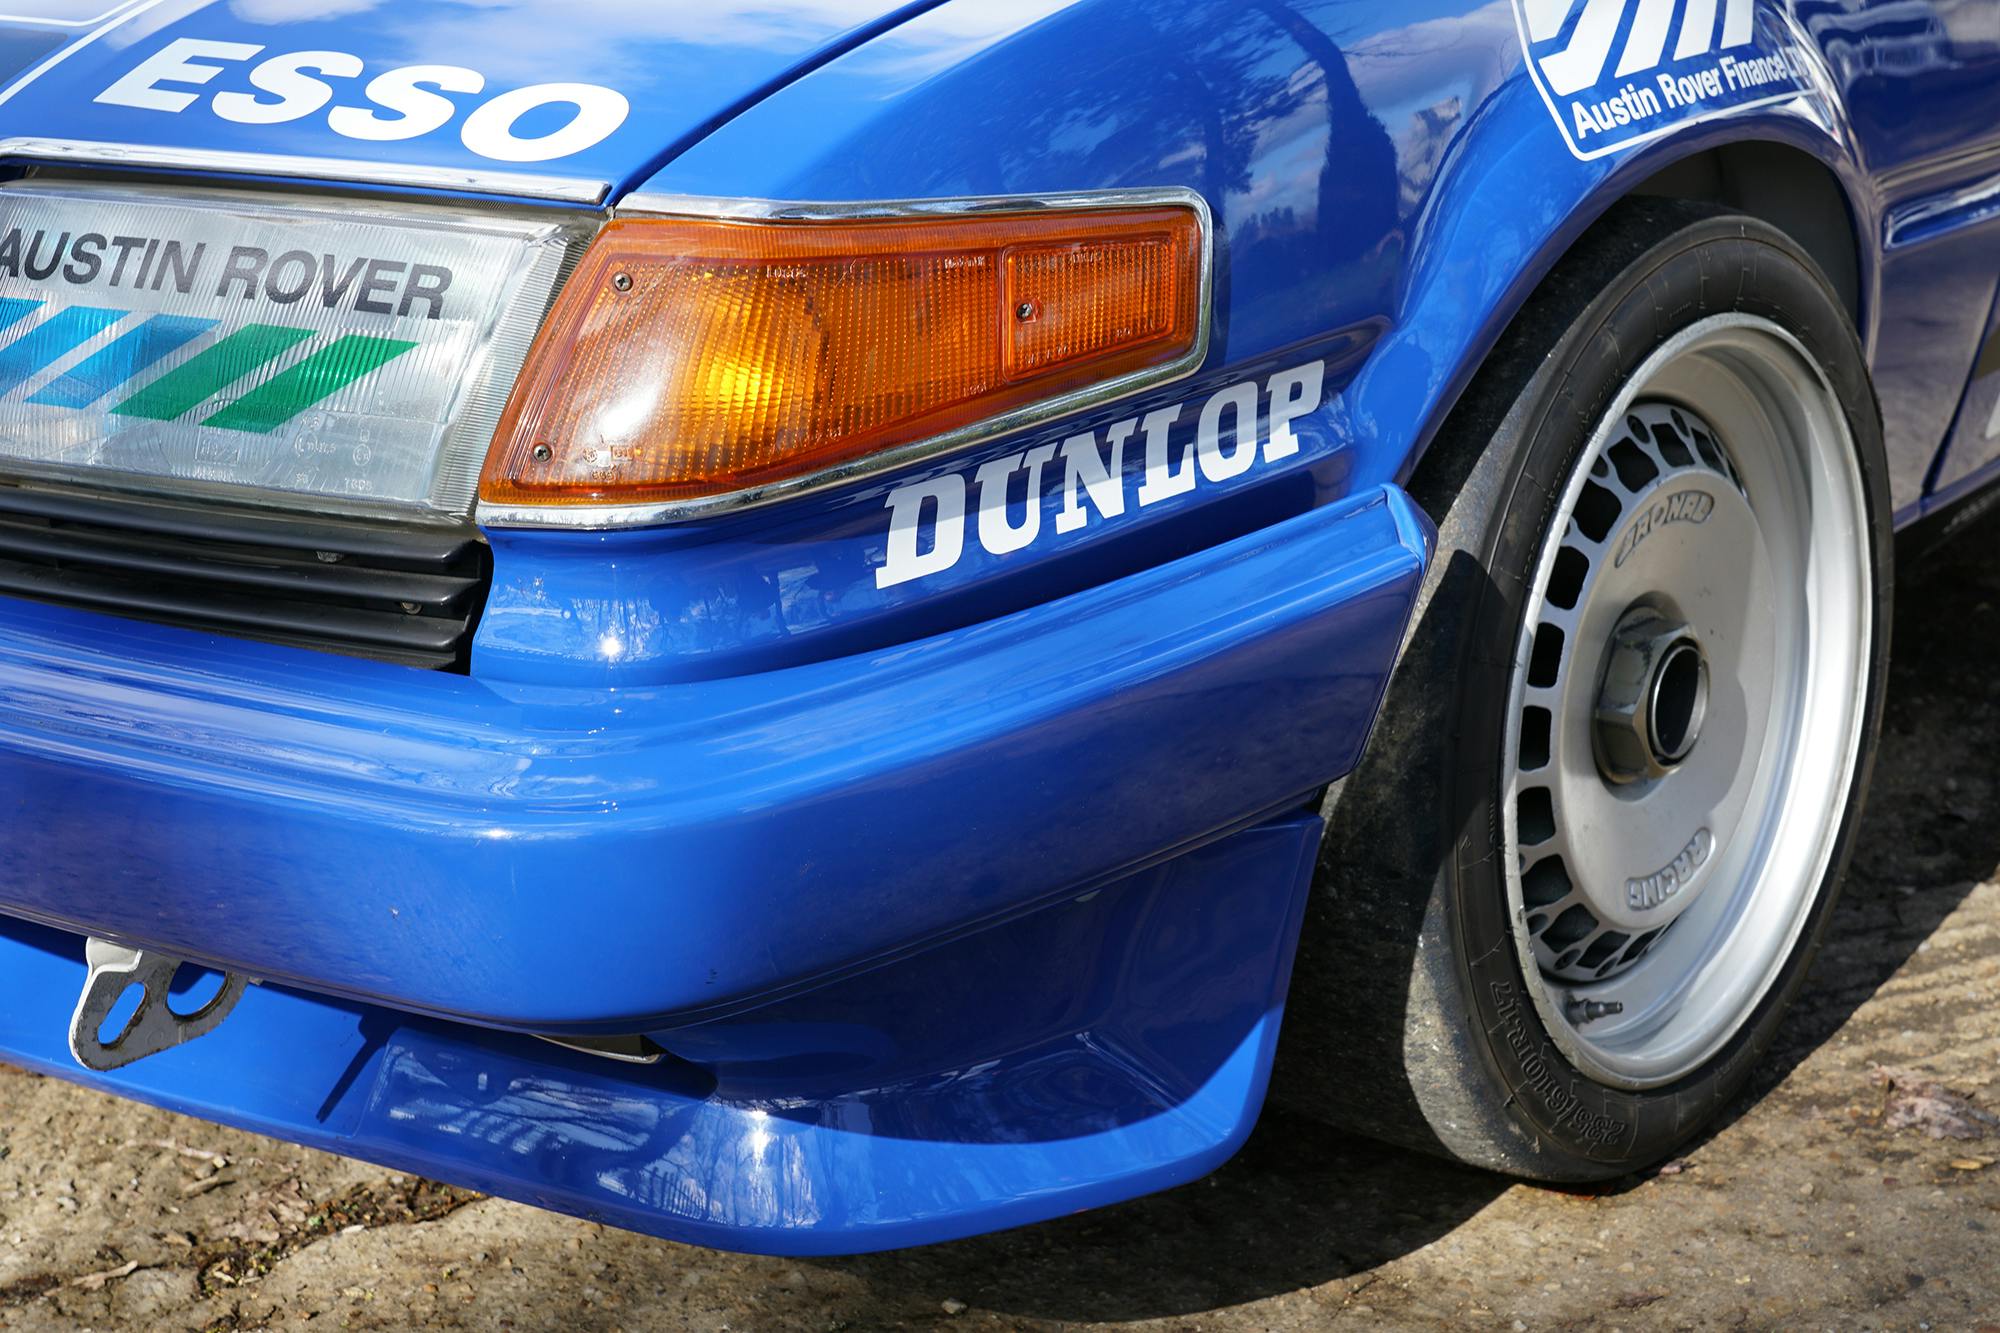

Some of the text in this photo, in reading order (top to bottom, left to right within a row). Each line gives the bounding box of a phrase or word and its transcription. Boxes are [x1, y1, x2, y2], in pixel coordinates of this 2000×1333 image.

[93, 37, 629, 162] ESSO
[1572, 83, 1661, 139] Austin
[1657, 73, 1723, 110] Rover
[1719, 55, 1787, 91] Finance
[0, 228, 453, 320] AUSTIN ROVER
[875, 360, 1325, 589] DUNLOP
[1628, 831, 1709, 908] RACING
